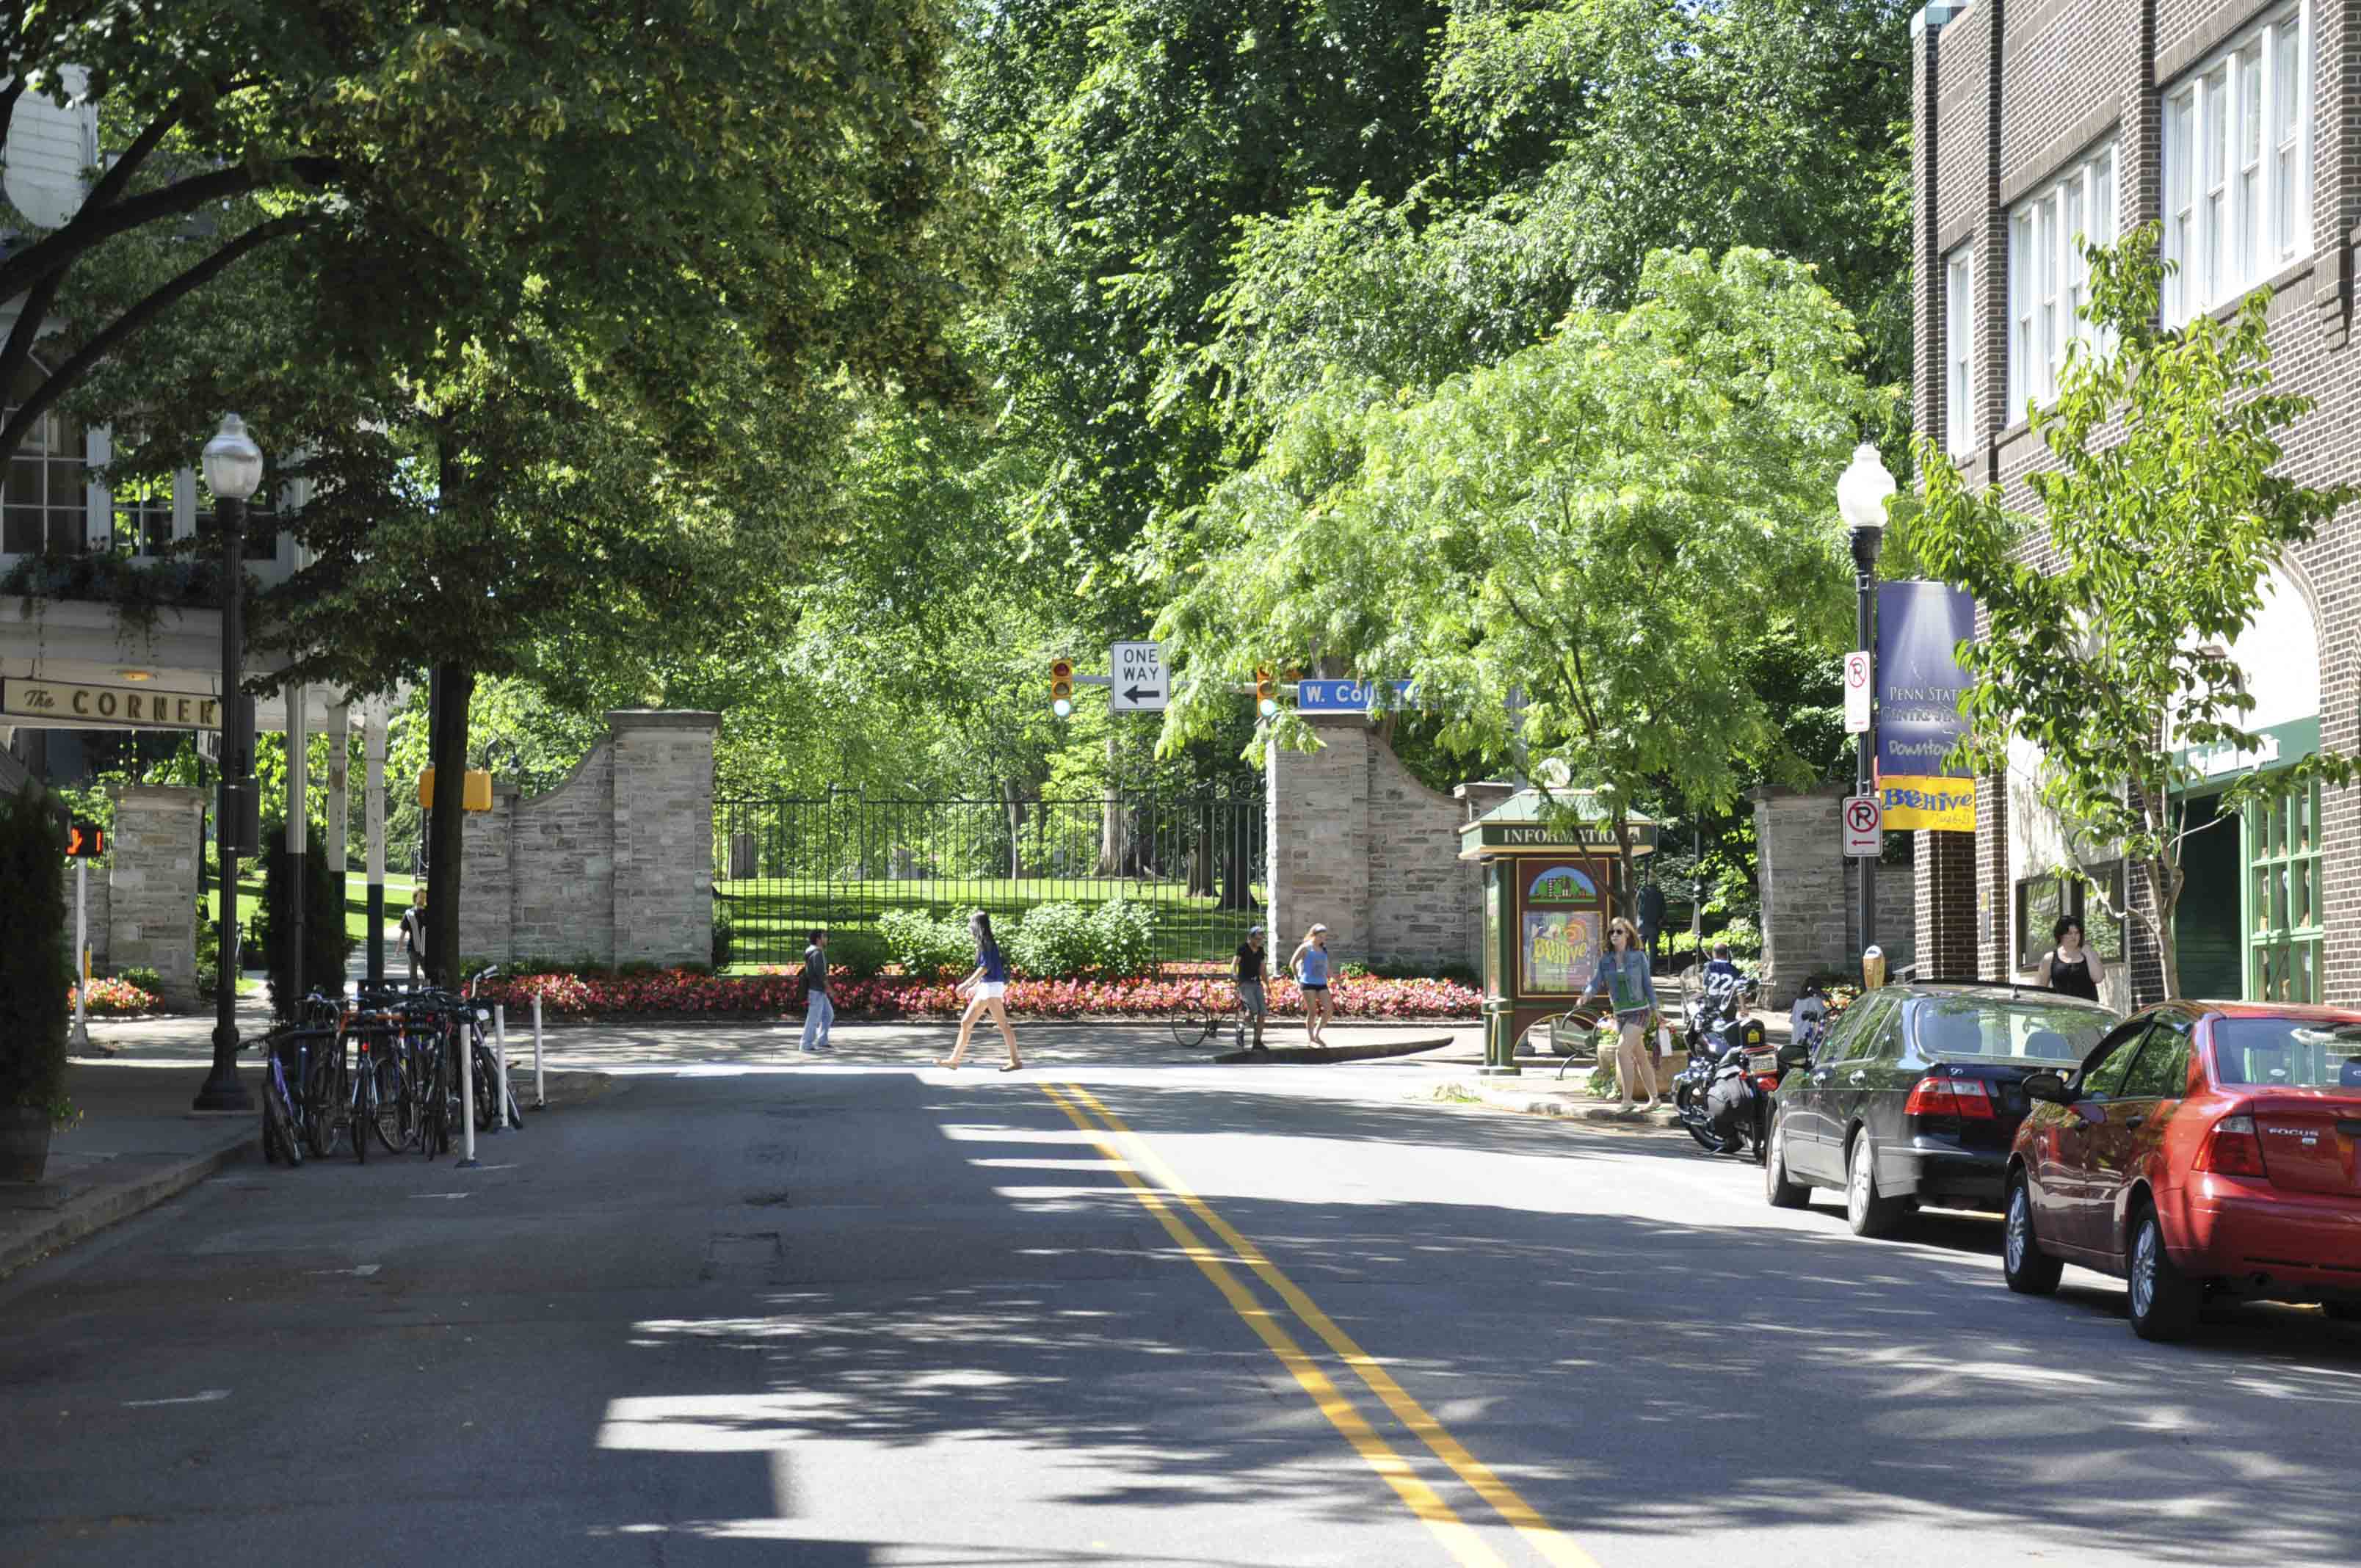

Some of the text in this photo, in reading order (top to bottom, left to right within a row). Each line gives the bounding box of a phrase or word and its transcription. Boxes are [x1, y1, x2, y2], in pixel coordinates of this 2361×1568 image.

[1124, 649, 1158, 663] ONE
[1123, 666, 1158, 681] WAY
[1306, 686, 1326, 703] W.
[1890, 686, 1962, 701] PENN STAT
[24, 689, 215, 725] The CORNER
[1504, 829, 1616, 843] INFORMATIO
[1708, 972, 1733, 995] 22
[2268, 1128, 2319, 1136] FOCUS
